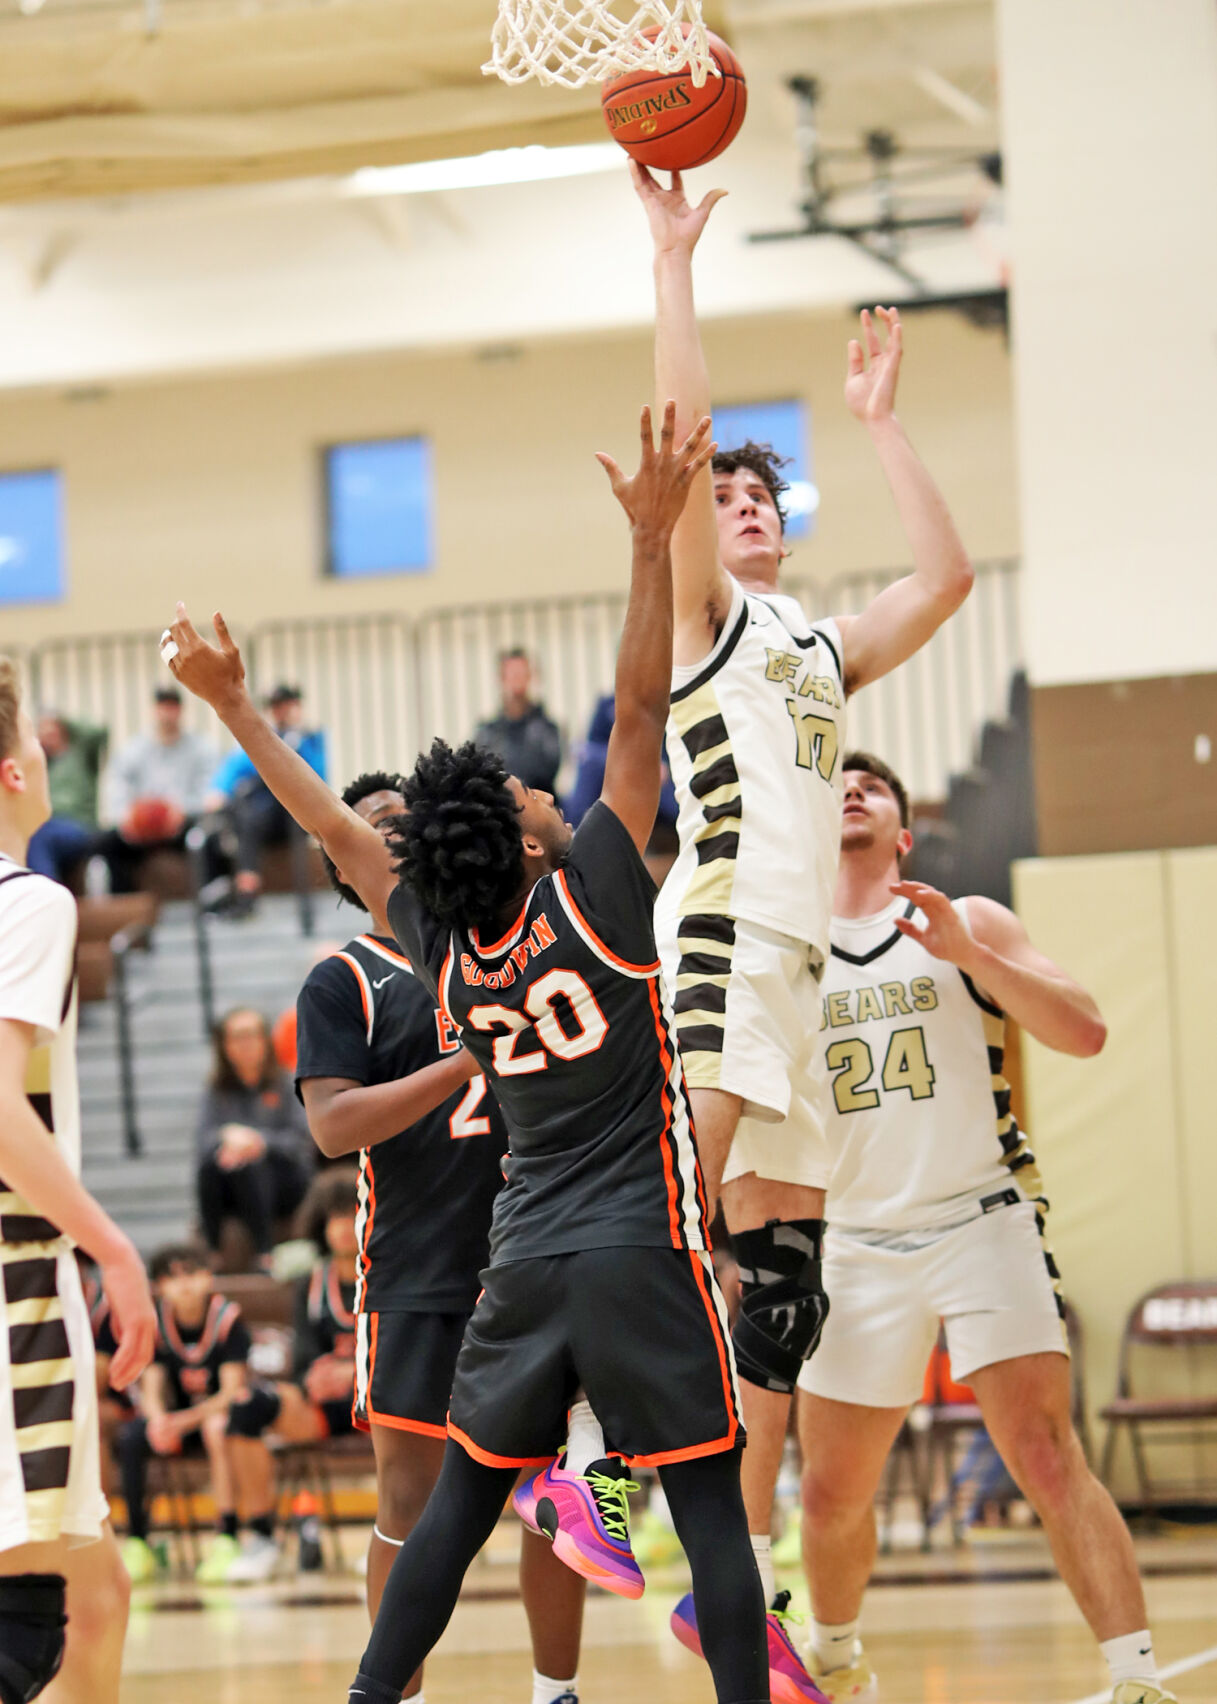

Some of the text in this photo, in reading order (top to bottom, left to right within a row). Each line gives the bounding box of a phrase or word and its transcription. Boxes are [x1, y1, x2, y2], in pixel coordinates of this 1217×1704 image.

[607, 83, 692, 129] SPALDING
[467, 968, 610, 1077] 20
[819, 976, 939, 1031] EARS
[825, 1026, 936, 1114] 24
